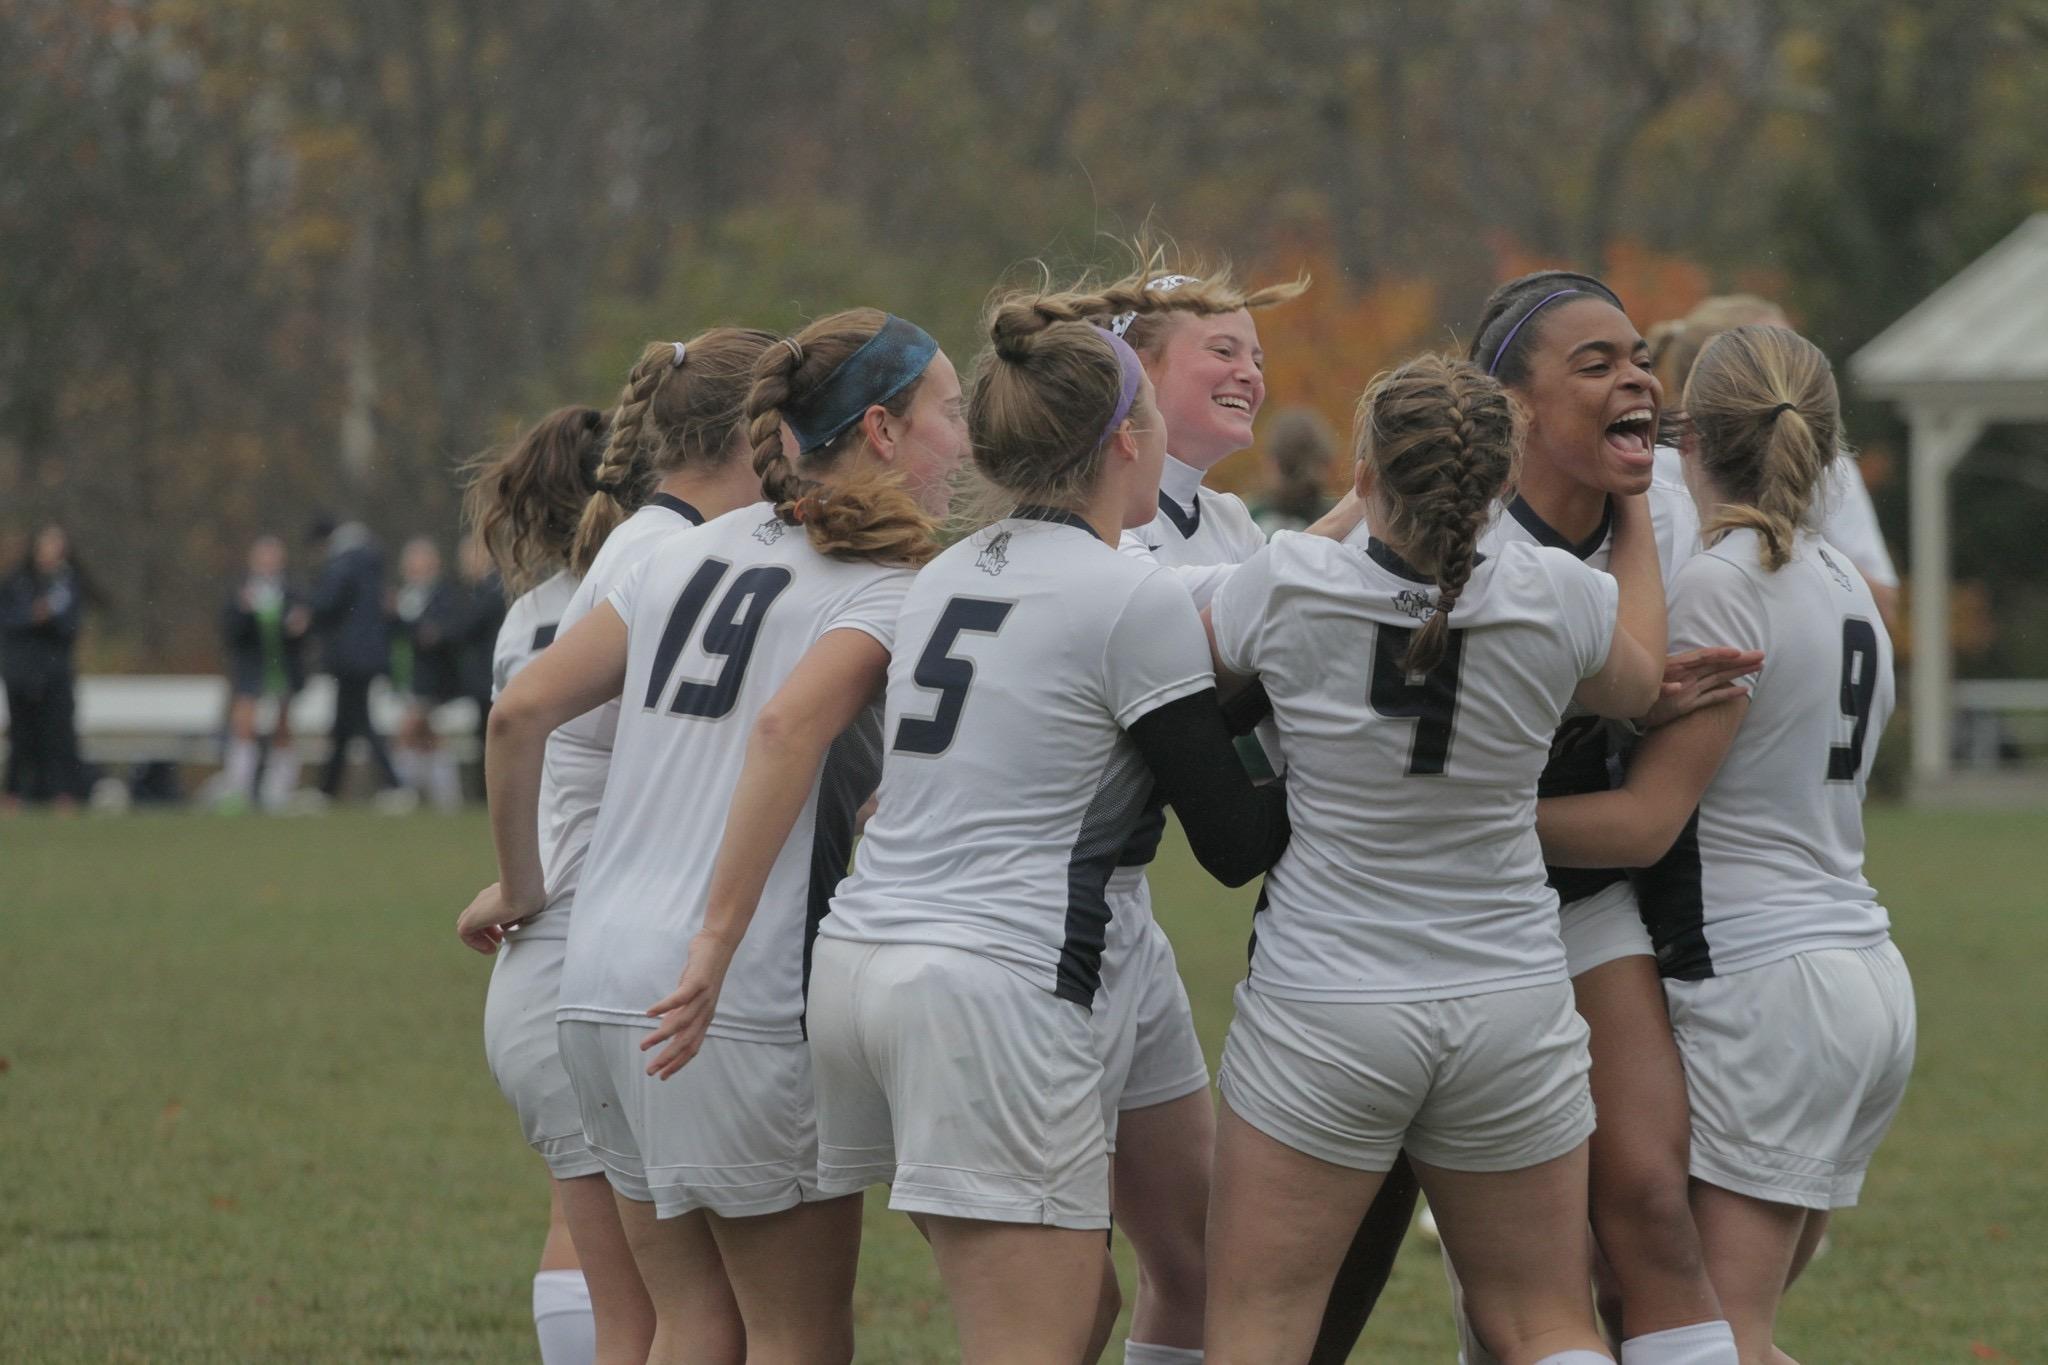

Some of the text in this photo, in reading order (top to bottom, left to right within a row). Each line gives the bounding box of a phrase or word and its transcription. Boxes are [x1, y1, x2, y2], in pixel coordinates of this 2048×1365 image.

[643, 555, 797, 722] 19
[890, 593, 1019, 759] 5
[1365, 622, 1468, 777] 4
[1824, 614, 1878, 785] 9
